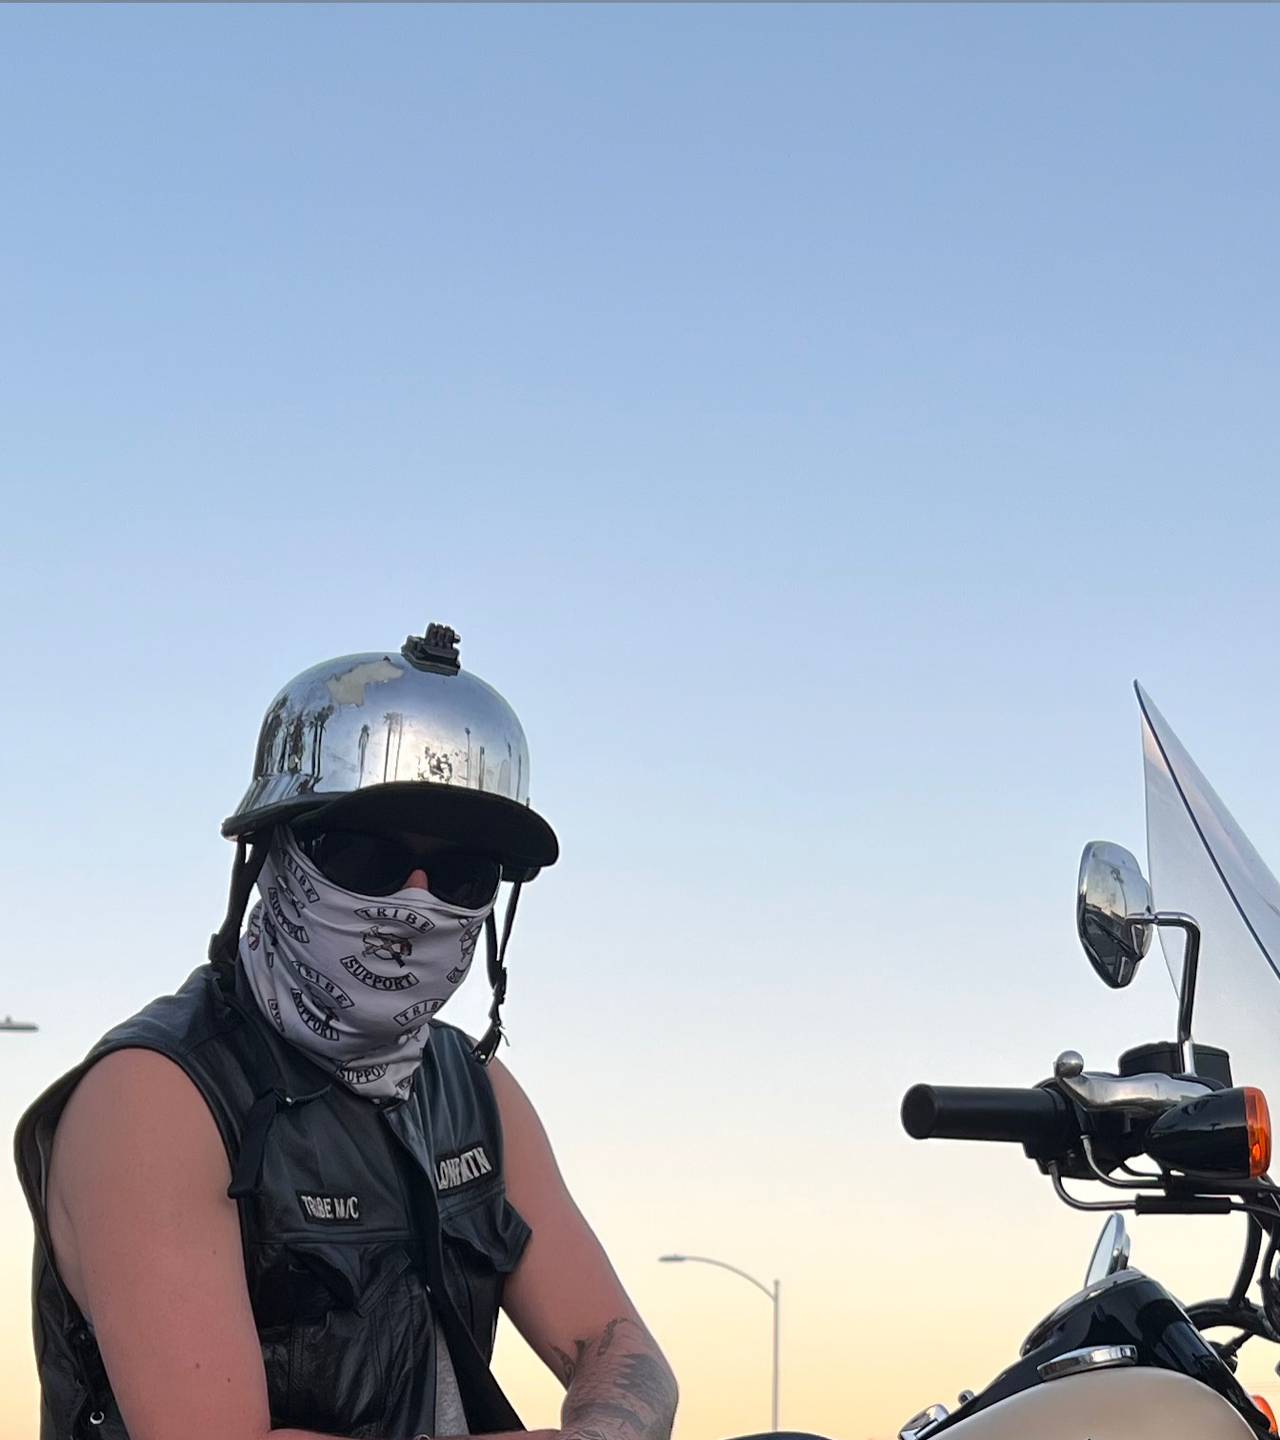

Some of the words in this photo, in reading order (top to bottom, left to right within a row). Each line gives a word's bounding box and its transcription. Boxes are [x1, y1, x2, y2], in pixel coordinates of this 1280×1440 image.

[361, 908, 431, 931] TRIBE
[344, 958, 413, 991] SUPPORT
[293, 992, 334, 1039] SUPPORT
[401, 1000, 445, 1021] TRIB
[336, 1064, 388, 1084] SUPPO
